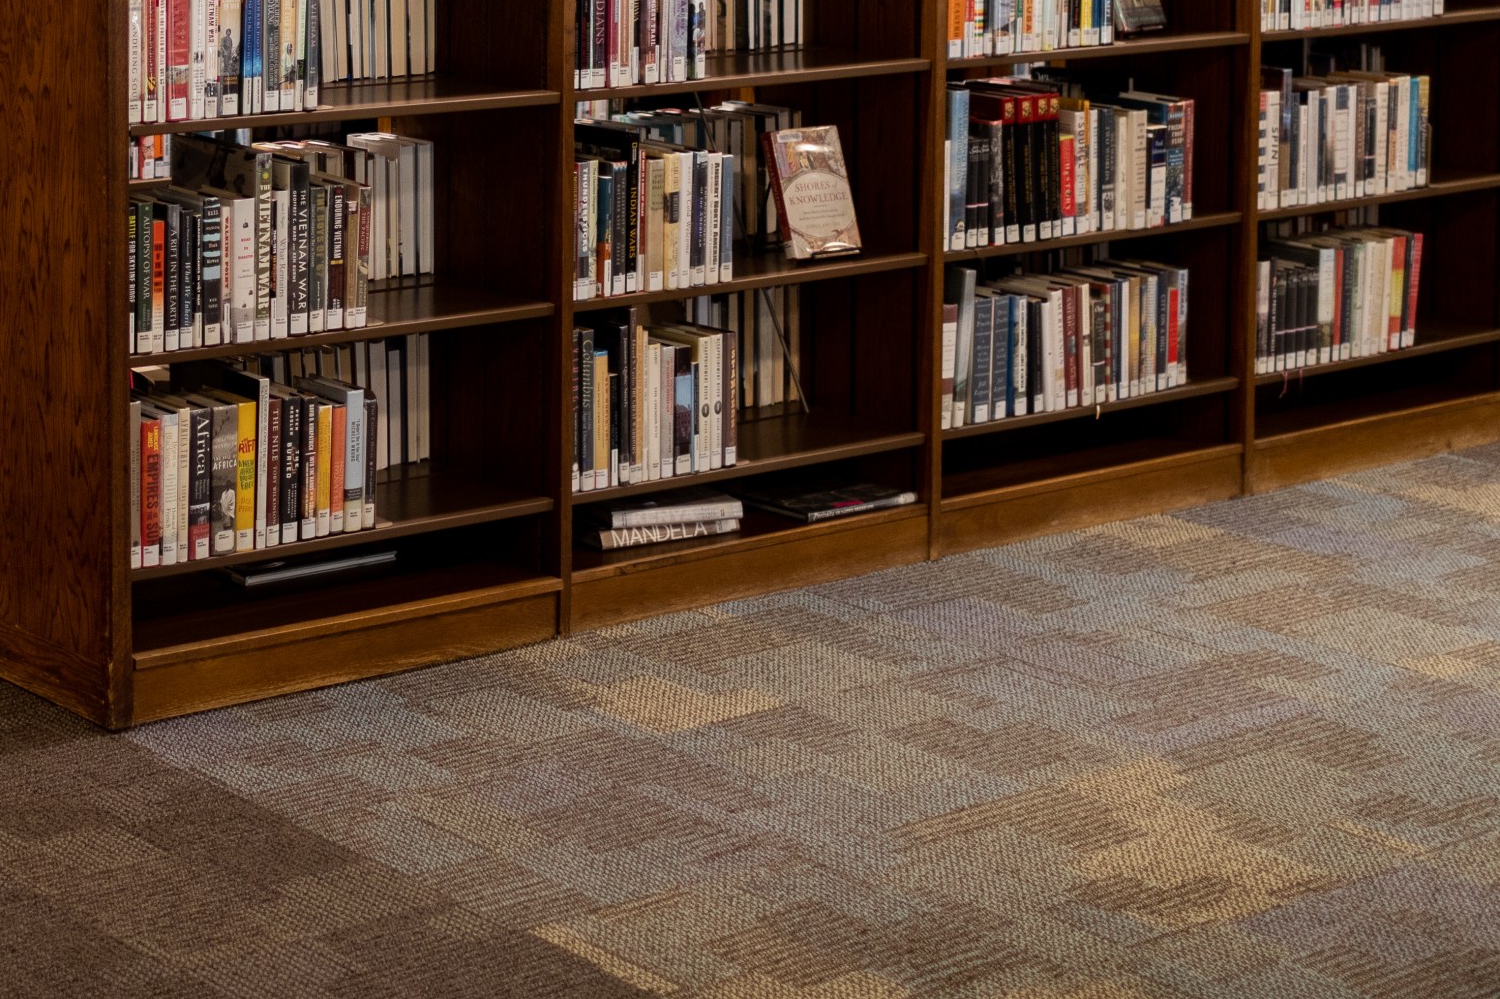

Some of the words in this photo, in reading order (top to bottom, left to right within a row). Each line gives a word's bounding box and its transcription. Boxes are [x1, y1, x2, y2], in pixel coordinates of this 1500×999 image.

[789, 192, 848, 206] KNOWLEDGE
[259, 191, 270, 268] VIETNAM
[299, 209, 307, 272] VIETNAM
[144, 261, 149, 273] OF
[171, 262, 176, 271] IN
[185, 286, 190, 297] We
[258, 271, 269, 309] WAR
[298, 278, 306, 309] WAR
[582, 340, 593, 408] Columbus
[197, 417, 209, 475] Africa
[213, 459, 236, 470] AFRICA
[147, 454, 159, 508] EMPIRES
[611, 523, 708, 548] MANDELA
